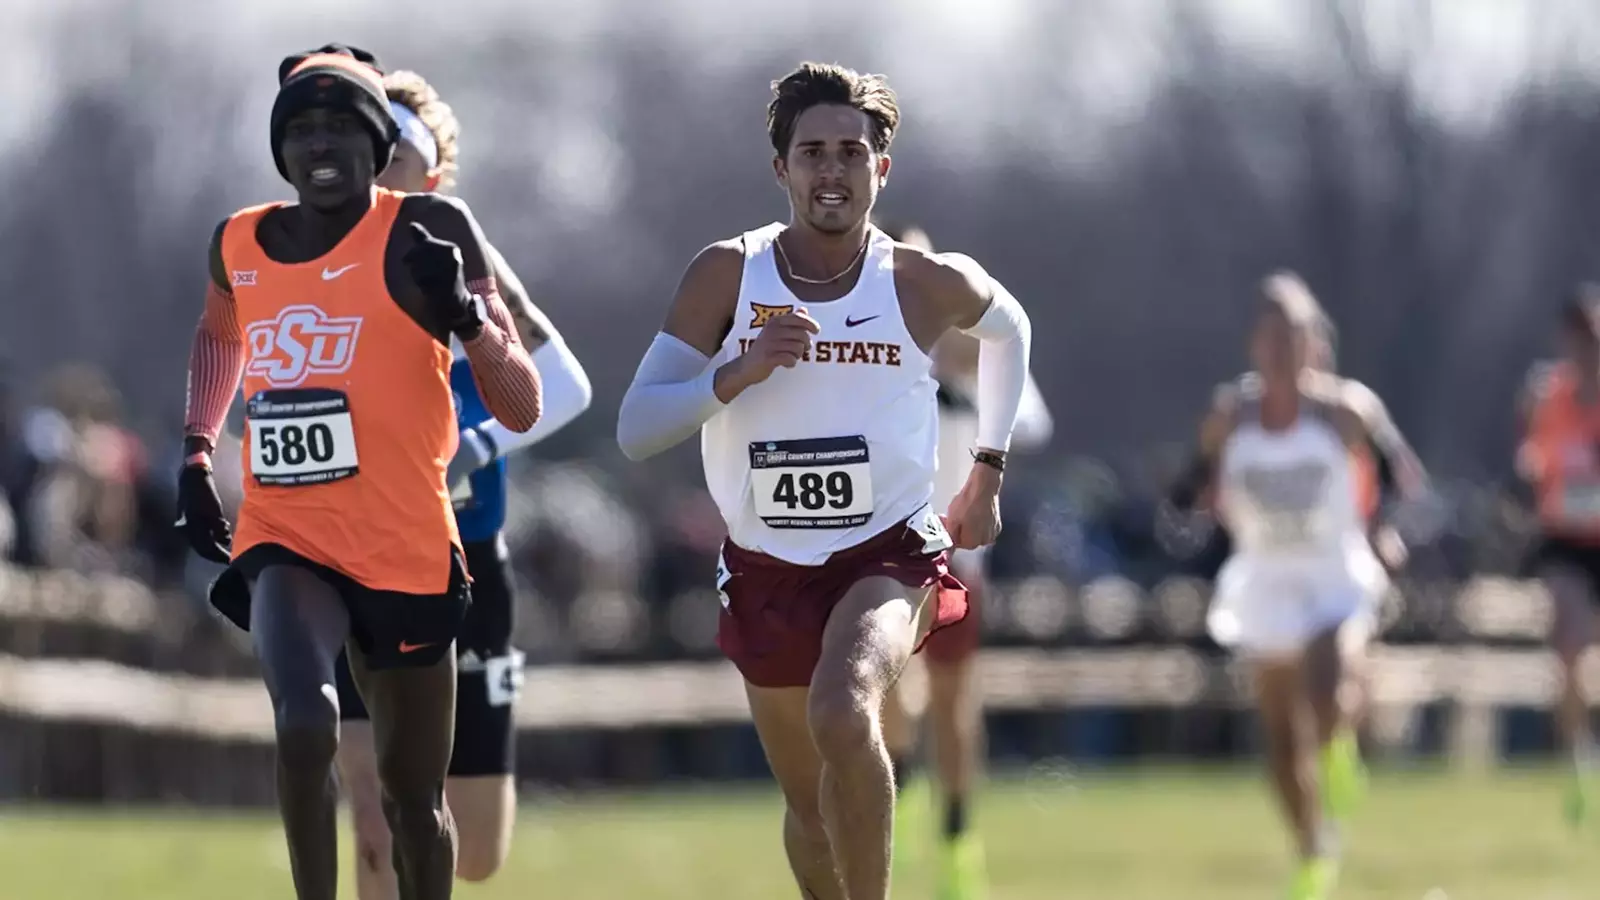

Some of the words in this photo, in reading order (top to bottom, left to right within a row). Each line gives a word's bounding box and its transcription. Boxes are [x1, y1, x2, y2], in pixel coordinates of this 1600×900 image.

[246, 305, 362, 388] OSU
[815, 341, 901, 366] STATE
[259, 422, 335, 467] 580
[772, 470, 853, 510] 489
